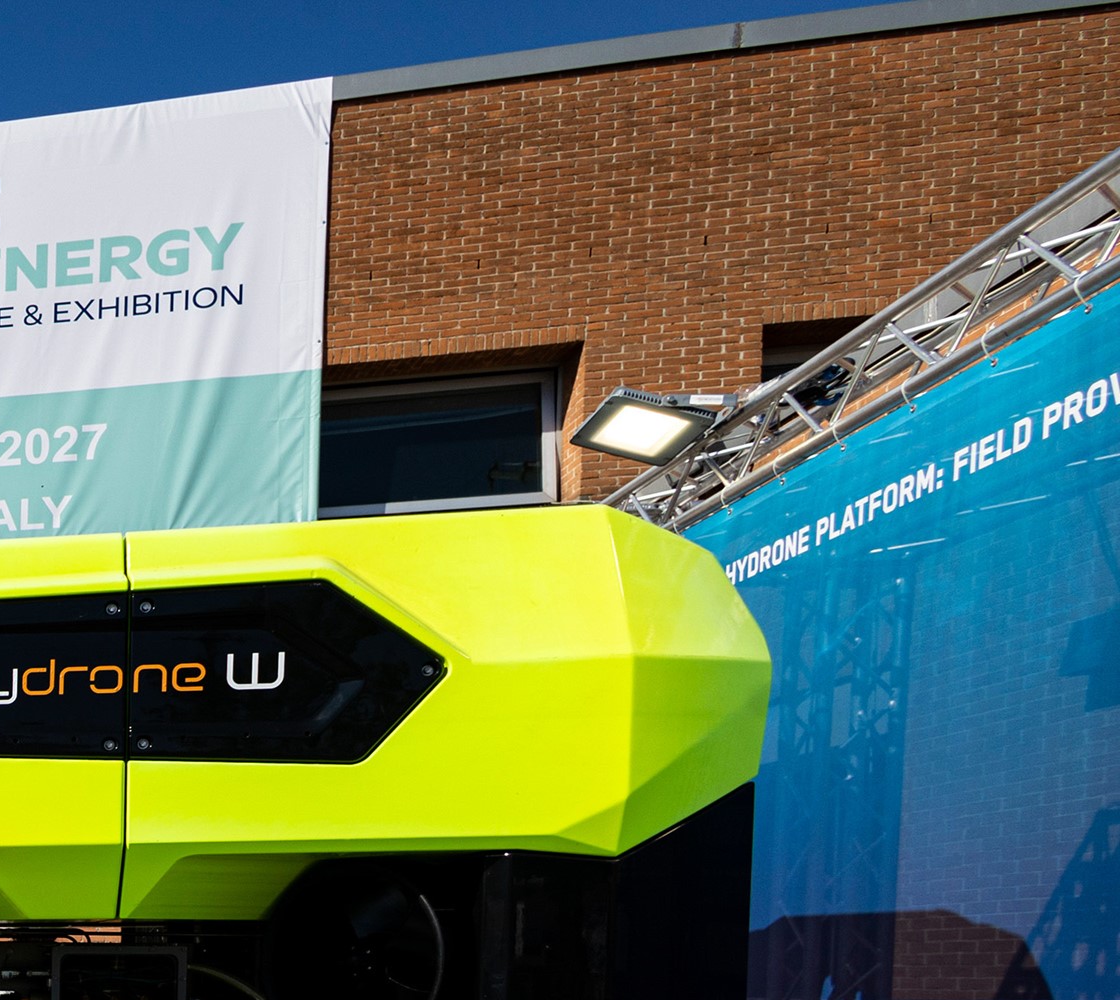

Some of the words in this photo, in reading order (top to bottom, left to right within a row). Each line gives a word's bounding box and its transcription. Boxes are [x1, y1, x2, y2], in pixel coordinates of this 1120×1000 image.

[23, 304, 43, 326] &
[53, 283, 244, 324] EXHIBITION
[725, 525, 810, 587] HYDRONE
[815, 463, 945, 547] PLATFORM:
[953, 416, 1033, 483] FIELD
[226, 651, 286, 691] W
